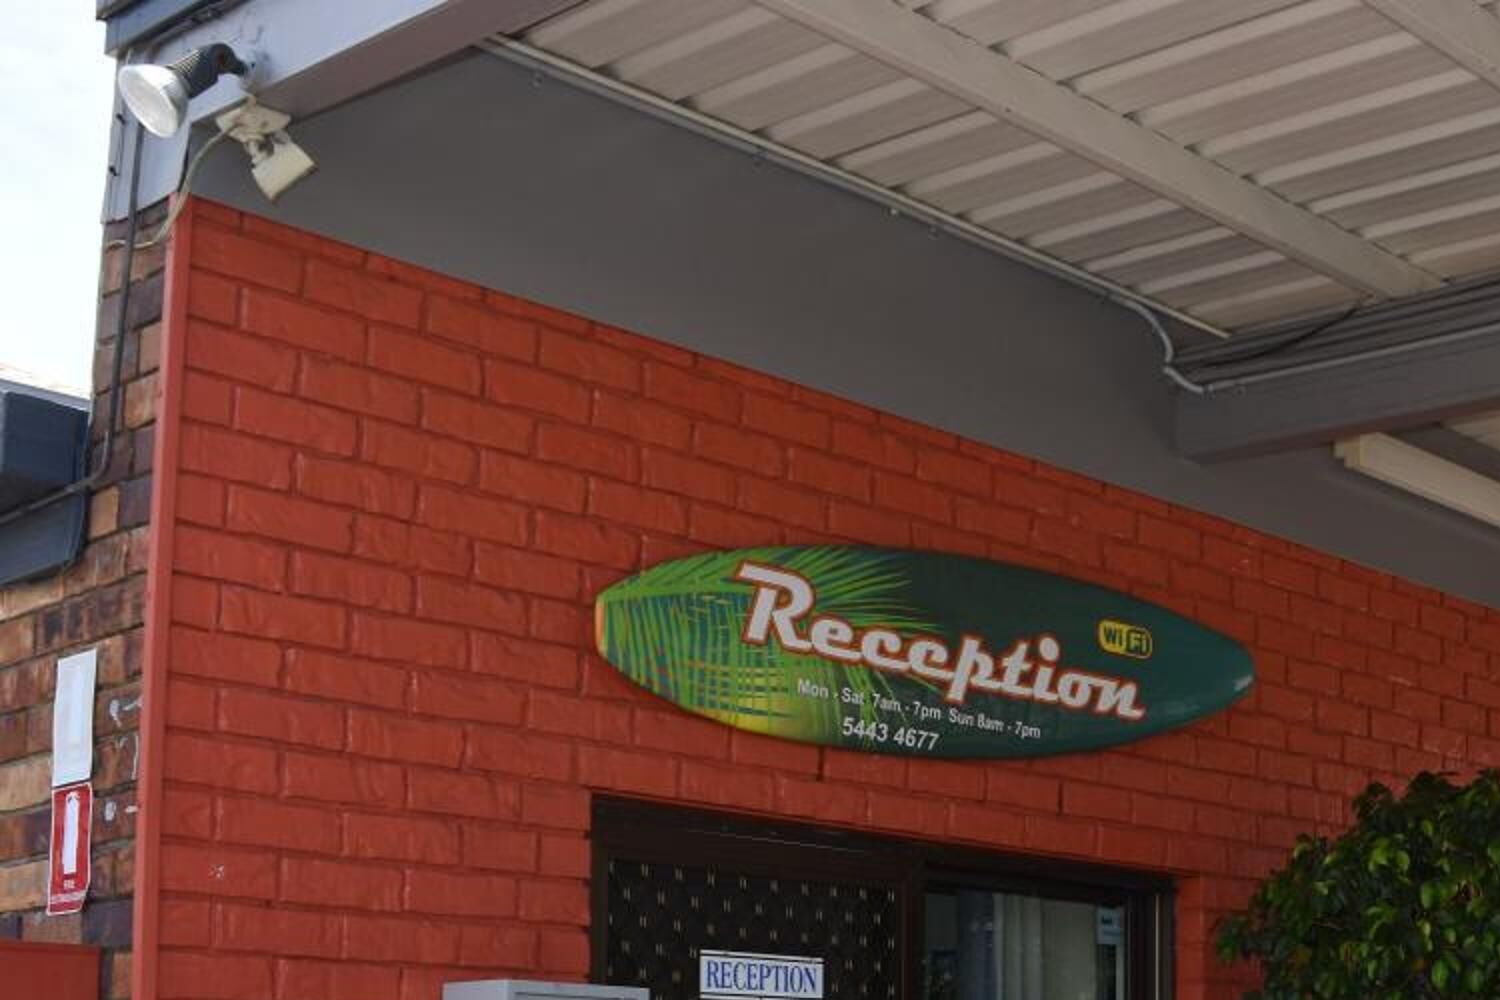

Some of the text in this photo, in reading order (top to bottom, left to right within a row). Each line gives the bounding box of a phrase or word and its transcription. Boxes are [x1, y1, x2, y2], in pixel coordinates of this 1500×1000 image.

[735, 559, 1146, 721] Reception
[797, 678, 829, 698] Mon
[841, 687, 865, 704] Sat
[872, 693, 902, 714] 7am
[913, 701, 942, 722] 7pm
[949, 708, 974, 728] Sun
[977, 713, 1004, 732] 8am
[1015, 721, 1042, 739] 7pm
[842, 717, 940, 751] 5443 4677
[706, 960, 817, 993] RECEPTION
